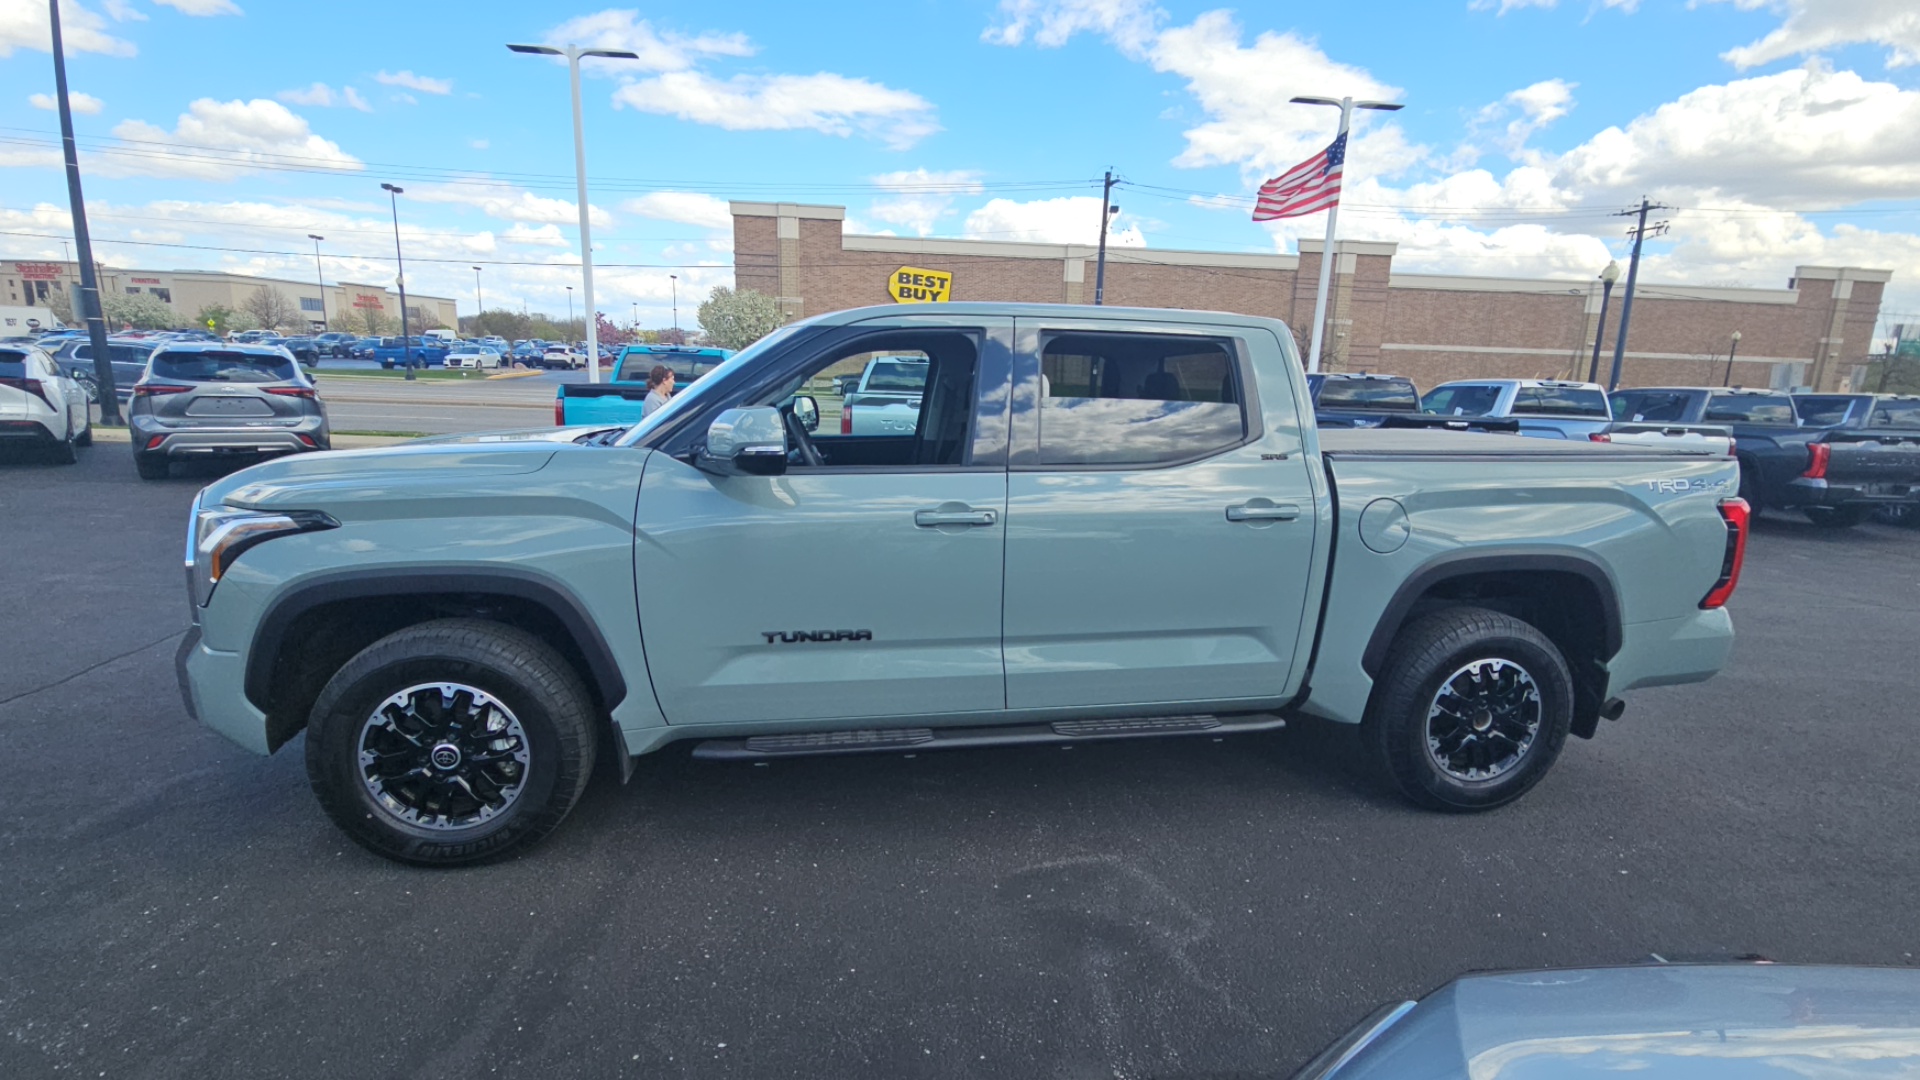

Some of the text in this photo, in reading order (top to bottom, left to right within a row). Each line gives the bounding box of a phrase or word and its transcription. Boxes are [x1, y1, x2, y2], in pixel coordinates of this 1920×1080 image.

[898, 272, 949, 289] BEST
[899, 286, 942, 302] BUY
[1642, 478, 1690, 494] TRD
[761, 629, 873, 644] TUNDRA
